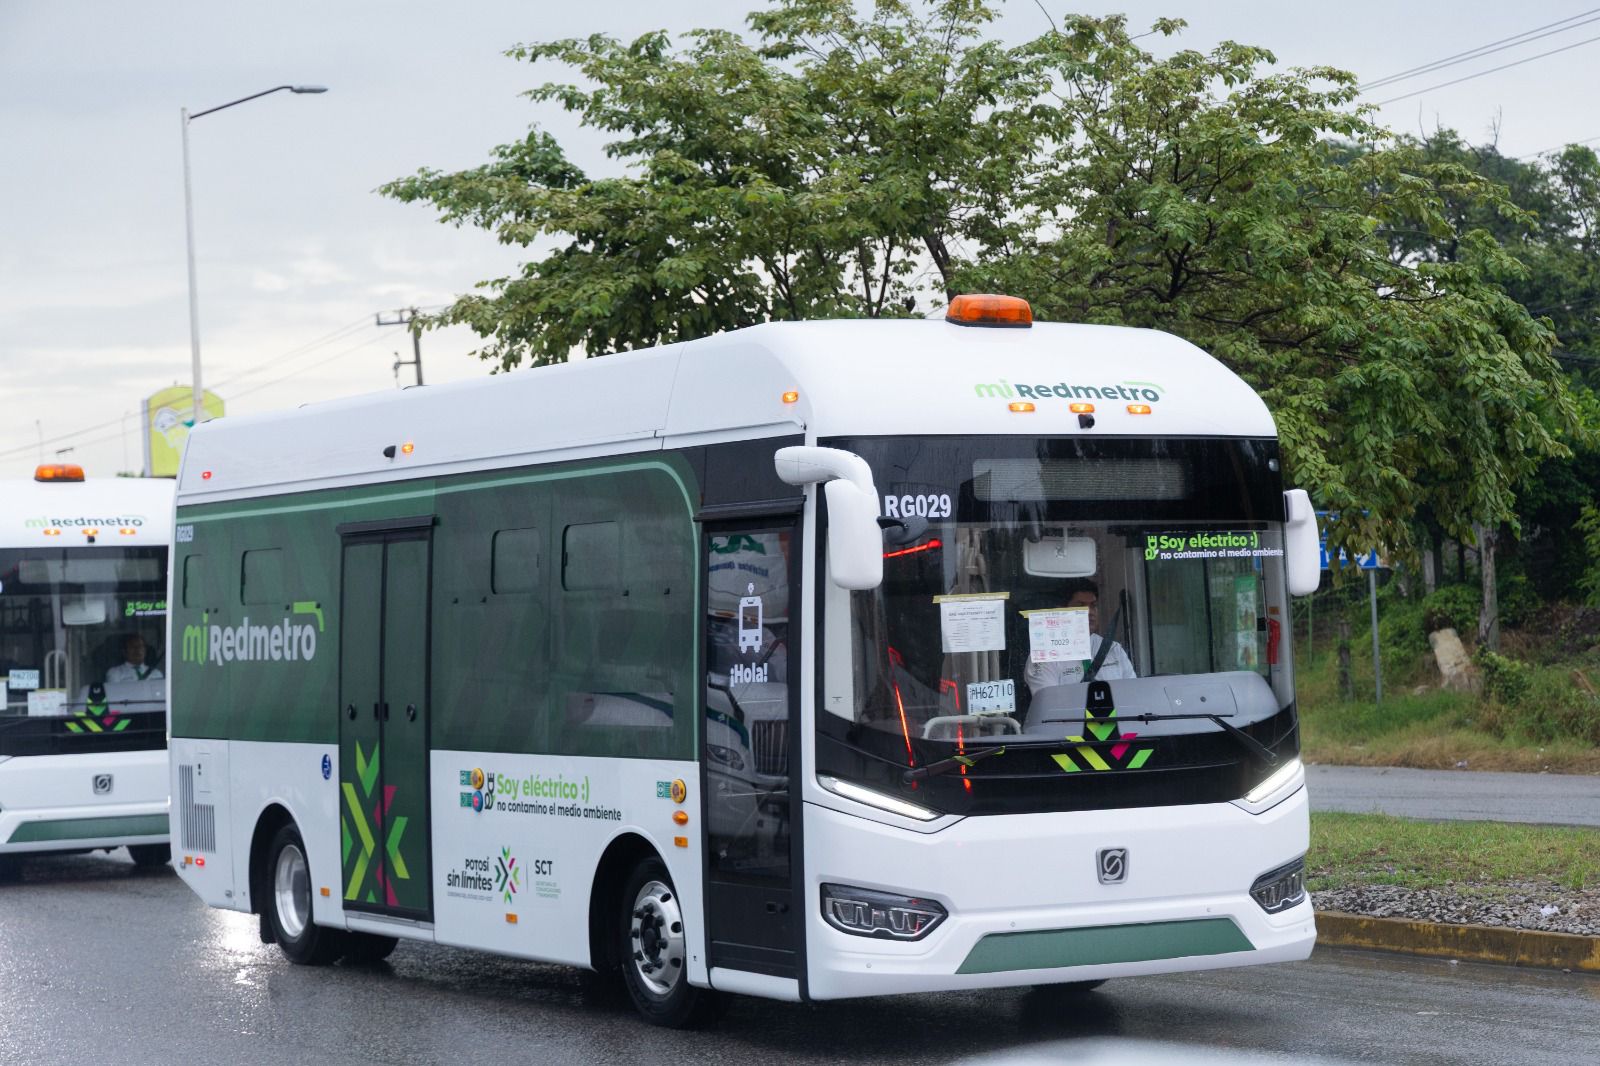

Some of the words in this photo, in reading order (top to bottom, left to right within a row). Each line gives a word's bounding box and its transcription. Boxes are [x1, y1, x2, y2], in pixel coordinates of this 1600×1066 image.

[974, 379, 1013, 399] mi
[1014, 382, 1160, 403] Redmetro
[884, 494, 952, 518] RG029
[51, 516, 143, 528] Redmetro
[1159, 535, 1186, 552] Soy
[1188, 531, 1248, 548] eléctrico
[1160, 552, 1172, 560] no
[1173, 548, 1217, 559] contamino
[1218, 548, 1227, 557] el
[1230, 547, 1252, 557] medio
[1252, 547, 1284, 557] ambiente
[182, 612, 209, 666] mi
[209, 616, 317, 667] Redmetro
[730, 662, 769, 688] ¡Hola!
[497, 774, 520, 800] Soy
[522, 774, 579, 801] eléctrico
[496, 801, 507, 812] no
[507, 801, 548, 815] contamino
[548, 804, 557, 815] el
[557, 805, 582, 818] medio
[583, 806, 622, 821] ambiente
[447, 868, 460, 888] sin
[534, 859, 553, 876] SCT
